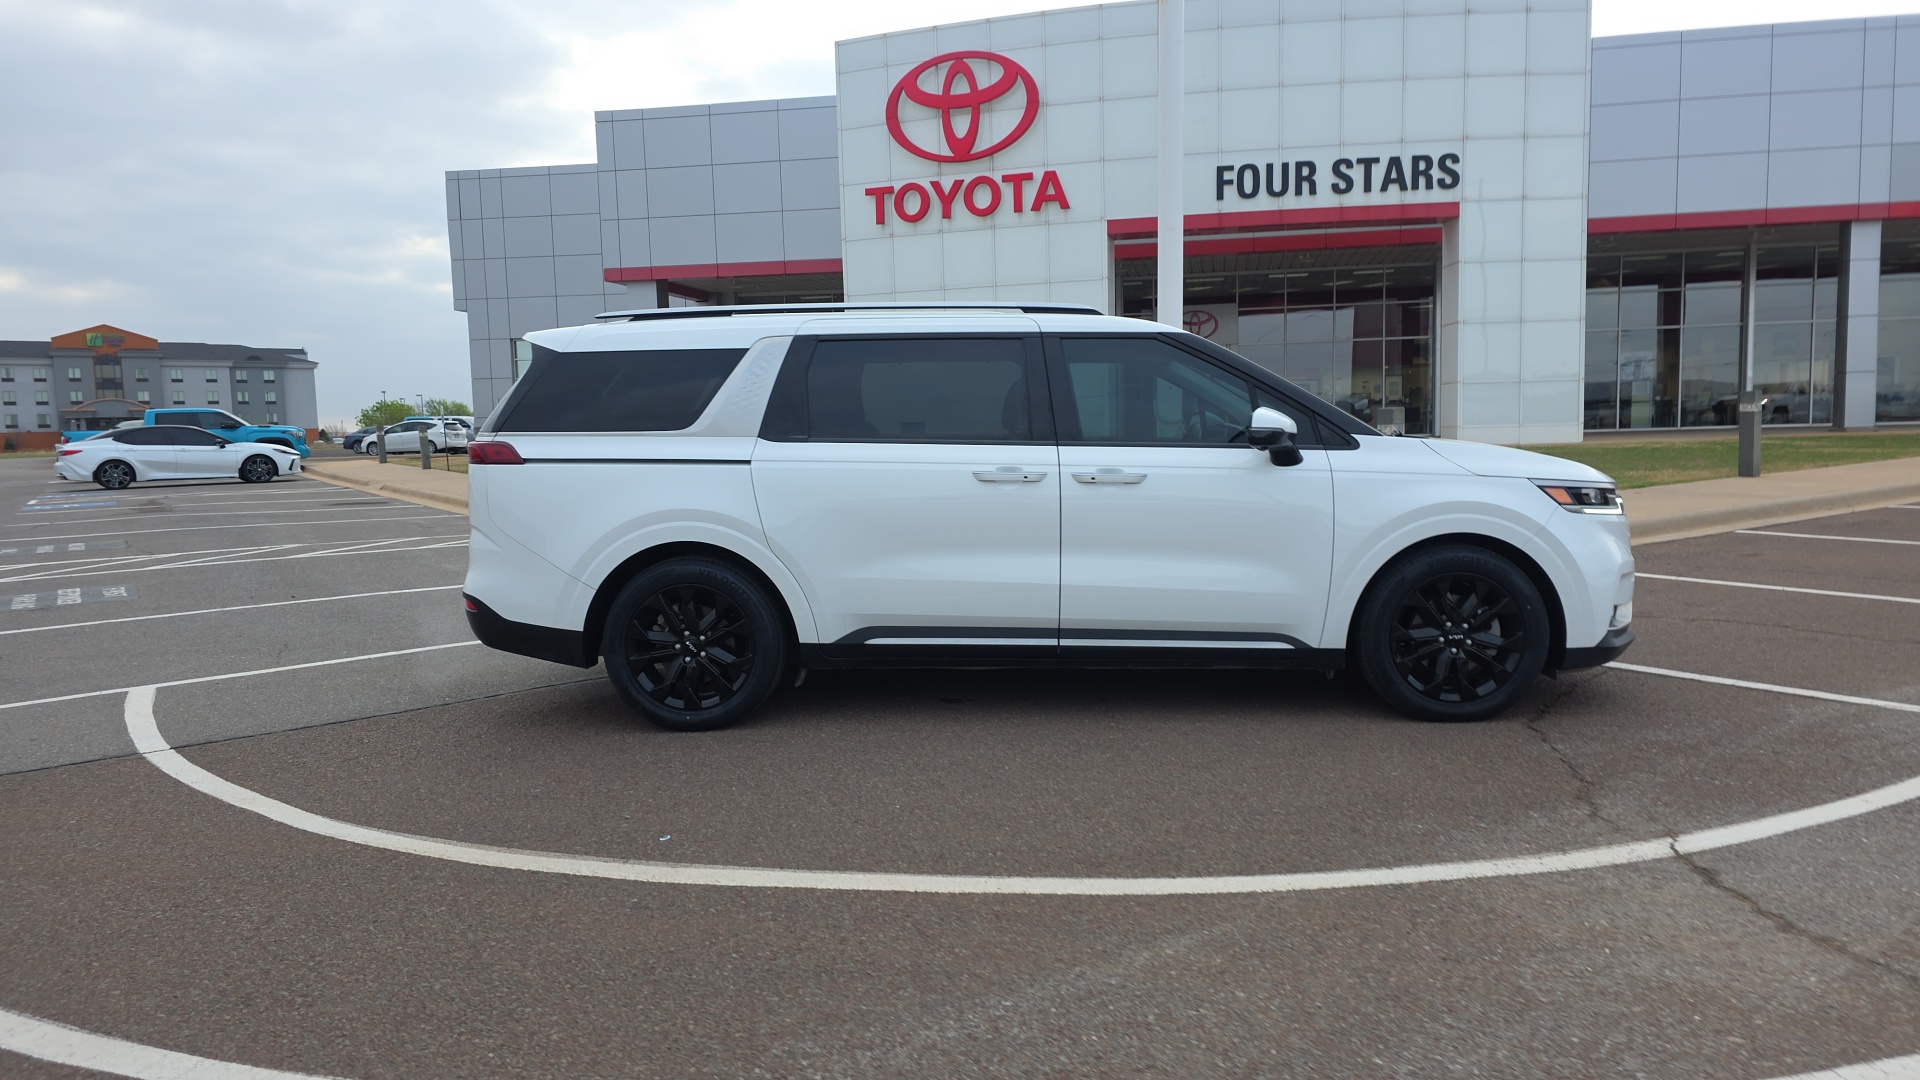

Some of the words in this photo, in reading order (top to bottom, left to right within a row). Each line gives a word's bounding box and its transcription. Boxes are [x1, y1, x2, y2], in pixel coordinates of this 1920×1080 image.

[864, 169, 1071, 226] TOYOTA
[1216, 160, 1318, 201] FOUR
[1331, 152, 1461, 195] STARS
[698, 568, 754, 602] VELOCITY
